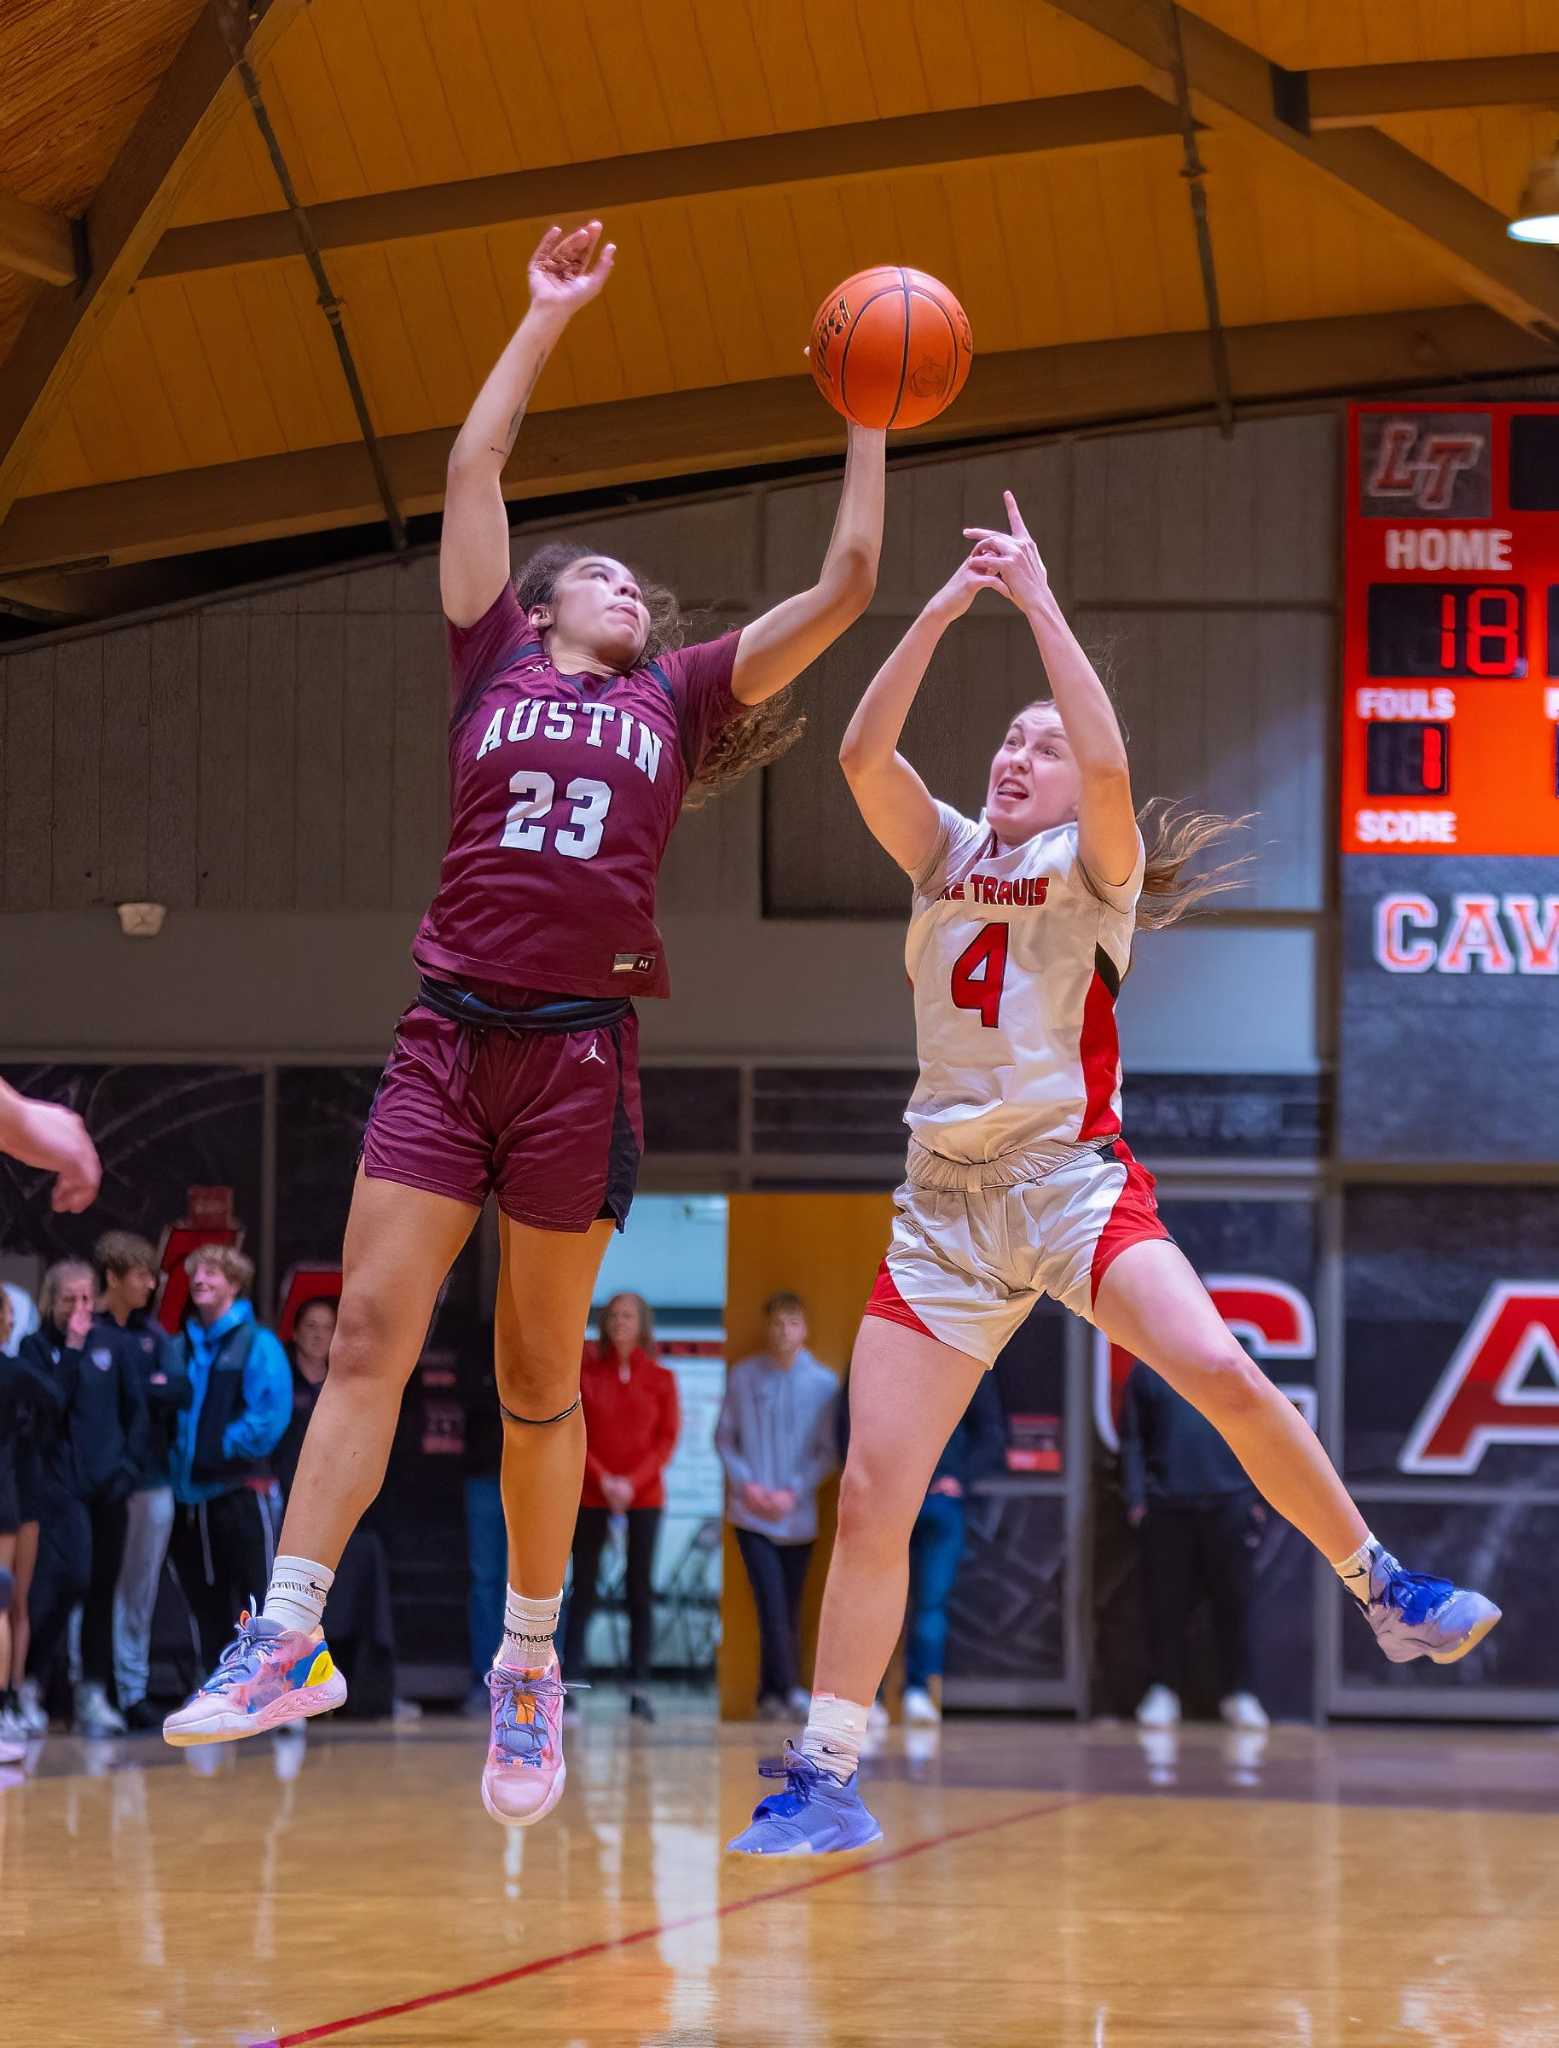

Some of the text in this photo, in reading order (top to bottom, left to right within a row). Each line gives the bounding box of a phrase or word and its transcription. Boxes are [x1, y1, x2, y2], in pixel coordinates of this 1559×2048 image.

[1368, 421, 1484, 510] LT
[1385, 528, 1513, 571] HOME
[1440, 588, 1520, 676] 18
[1356, 687, 1456, 720] FOULS
[476, 698, 664, 785] AUSTIN
[1422, 727, 1442, 790] 1
[500, 769, 613, 861] 23
[1356, 810, 1457, 844] SCORE
[970, 873, 1050, 907] TRAVIS
[951, 921, 1010, 1029] 4
